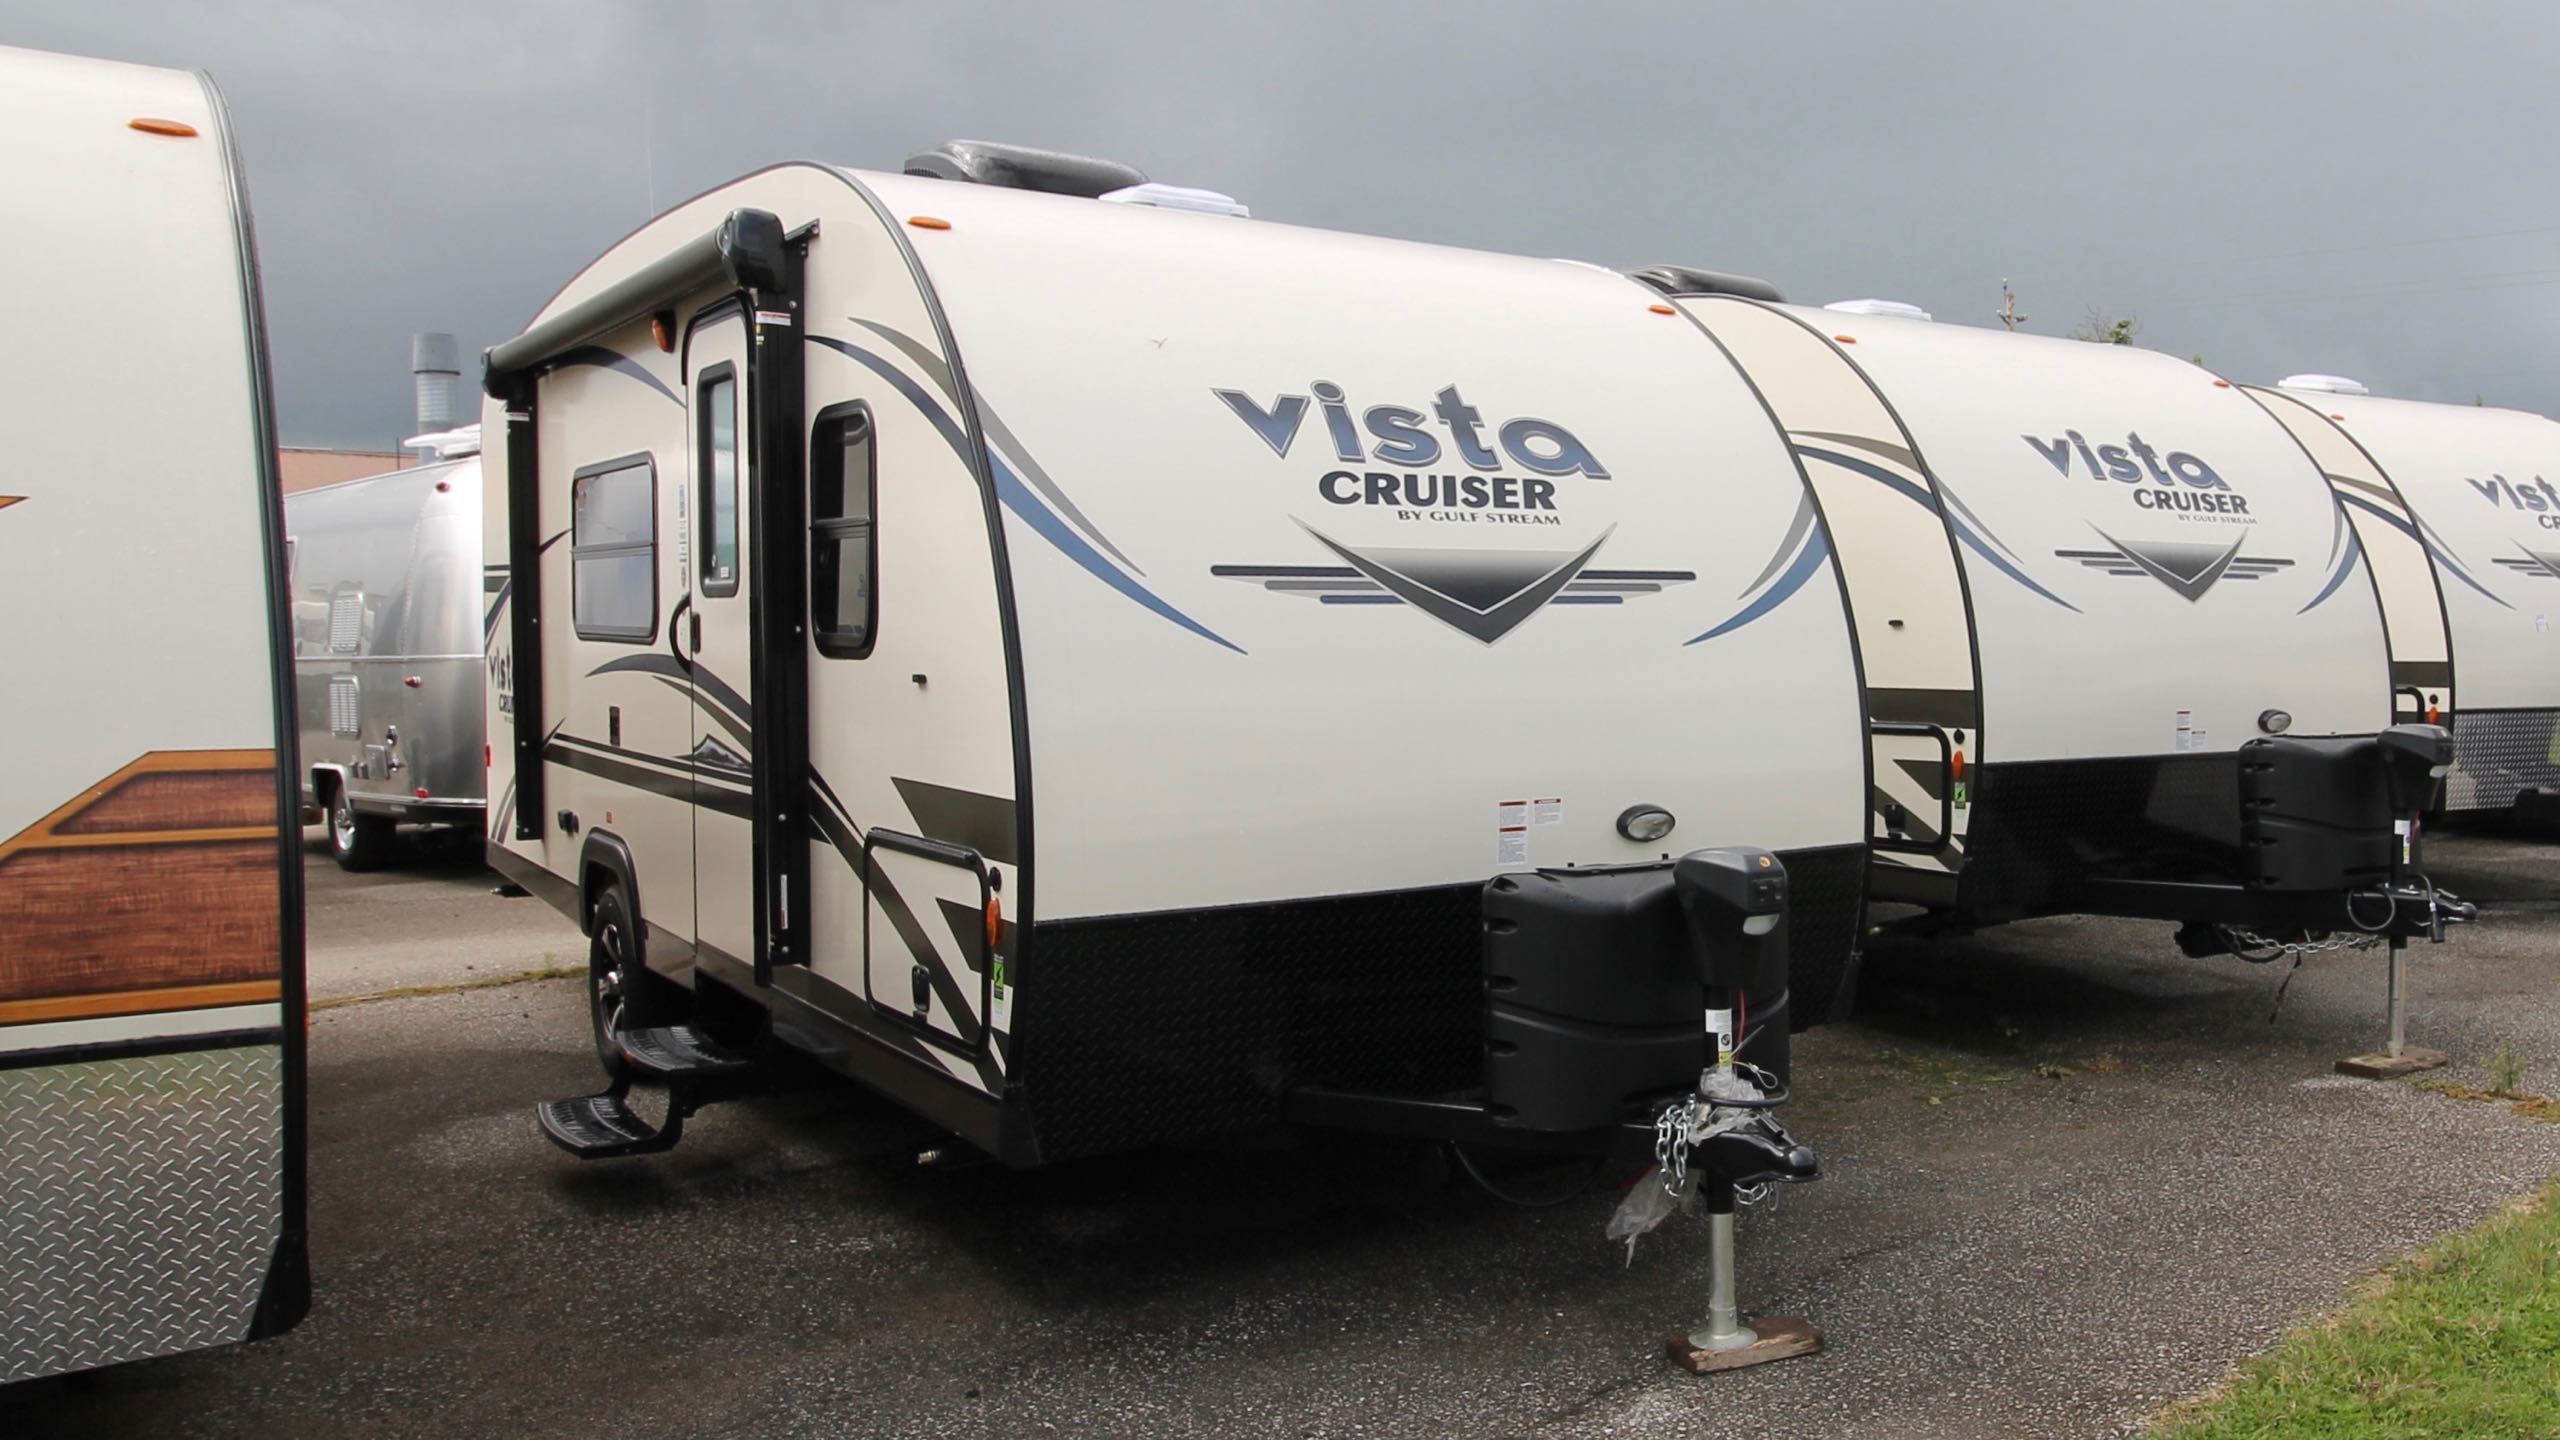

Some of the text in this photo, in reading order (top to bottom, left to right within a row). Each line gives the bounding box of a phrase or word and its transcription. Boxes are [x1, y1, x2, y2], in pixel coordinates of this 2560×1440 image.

[1209, 378, 1613, 482] vista
[2020, 428, 2233, 492] vista
[1318, 470, 1558, 511] CRUISER
[2132, 488, 2251, 515] CRUISER
[2463, 473, 2560, 513] vist
[1397, 510, 1562, 526] BY GULF STREAM
